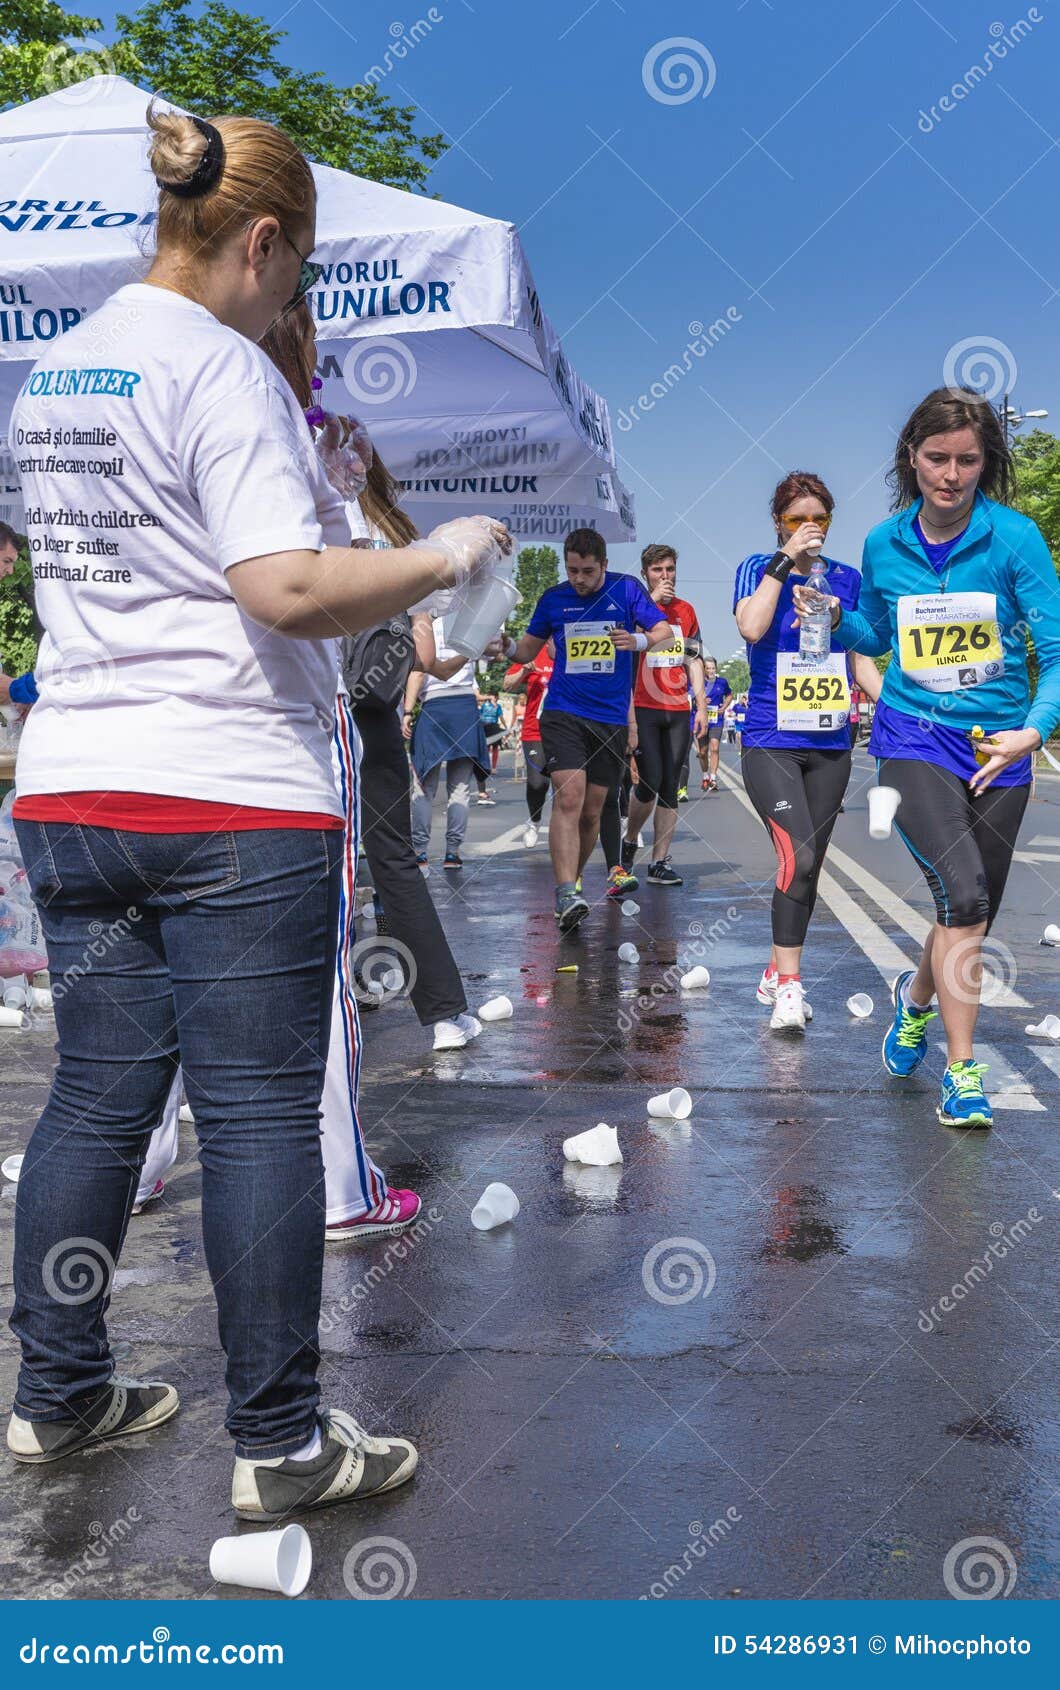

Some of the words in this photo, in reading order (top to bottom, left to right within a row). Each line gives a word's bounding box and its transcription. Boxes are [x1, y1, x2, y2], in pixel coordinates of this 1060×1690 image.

[319, 259, 403, 285] VORUL
[306, 281, 452, 321] UNILOR
[17, 429, 24, 446] O
[64, 431, 71, 445] o
[72, 427, 117, 447] familie
[45, 455, 86, 474] fiecare
[88, 458, 125, 478] copil
[92, 511, 165, 529] children
[92, 569, 132, 584] care
[570, 640, 611, 657] 5722
[909, 624, 991, 658] 1726
[936, 654, 967, 666] ILINCA
[783, 678, 844, 701] 5652
